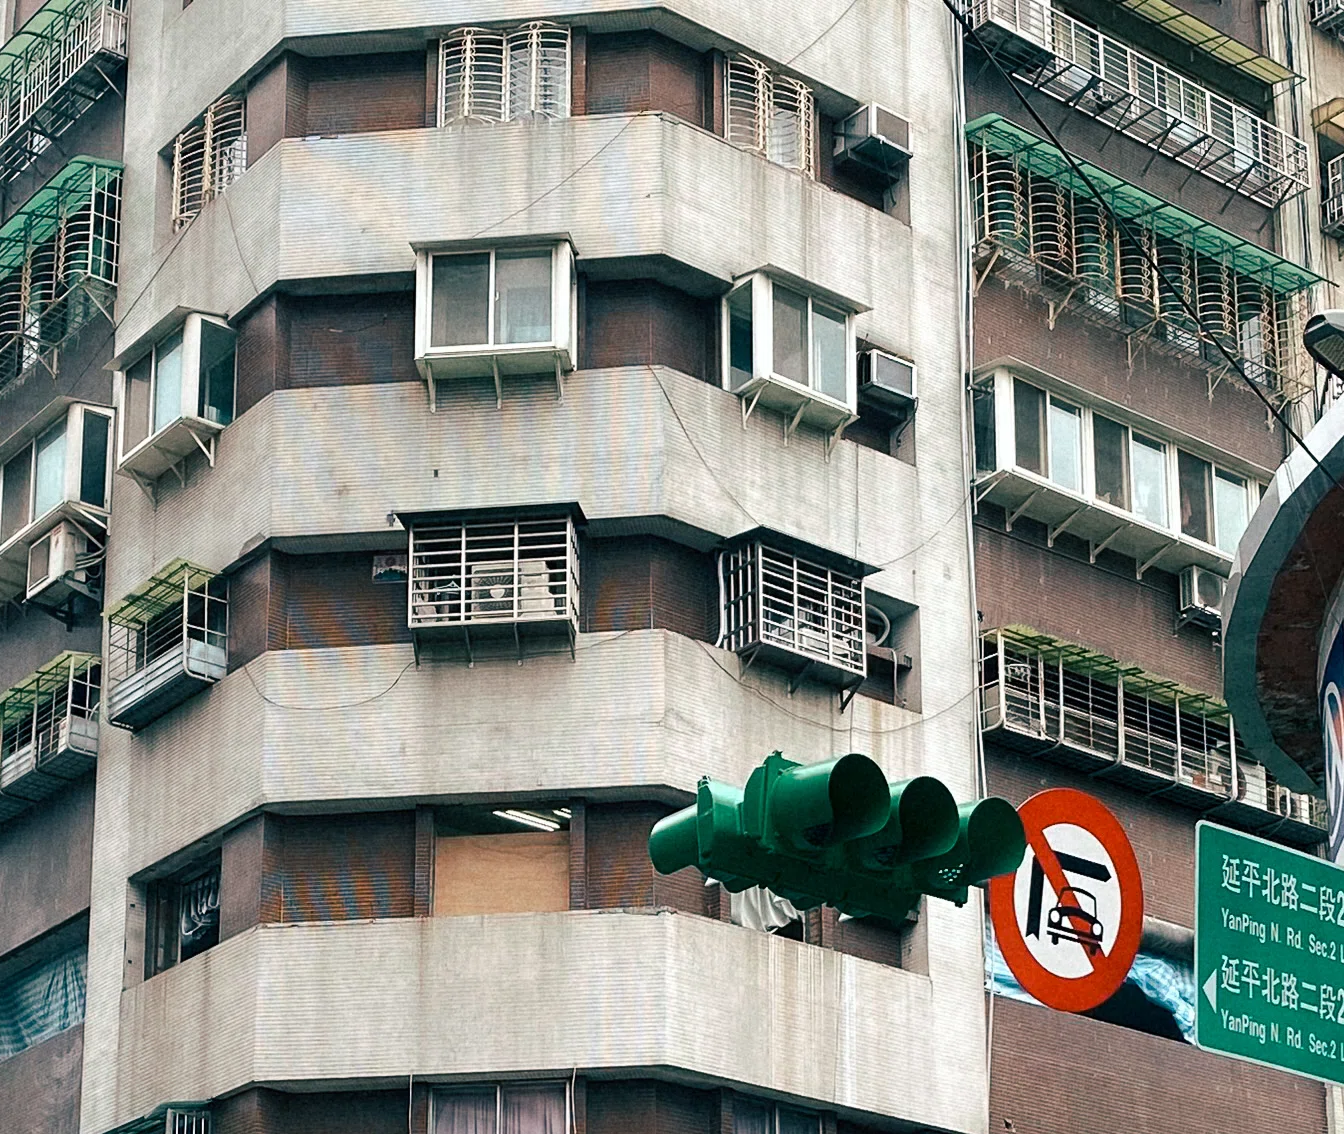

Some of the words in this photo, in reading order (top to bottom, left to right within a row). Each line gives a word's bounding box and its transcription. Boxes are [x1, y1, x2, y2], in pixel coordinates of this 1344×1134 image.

[1221, 907, 1267, 943] YanPing
[1308, 934, 1337, 961] Sec.2
[1221, 1008, 1267, 1045] YanPing
[1308, 1033, 1337, 1060] Sec.2
